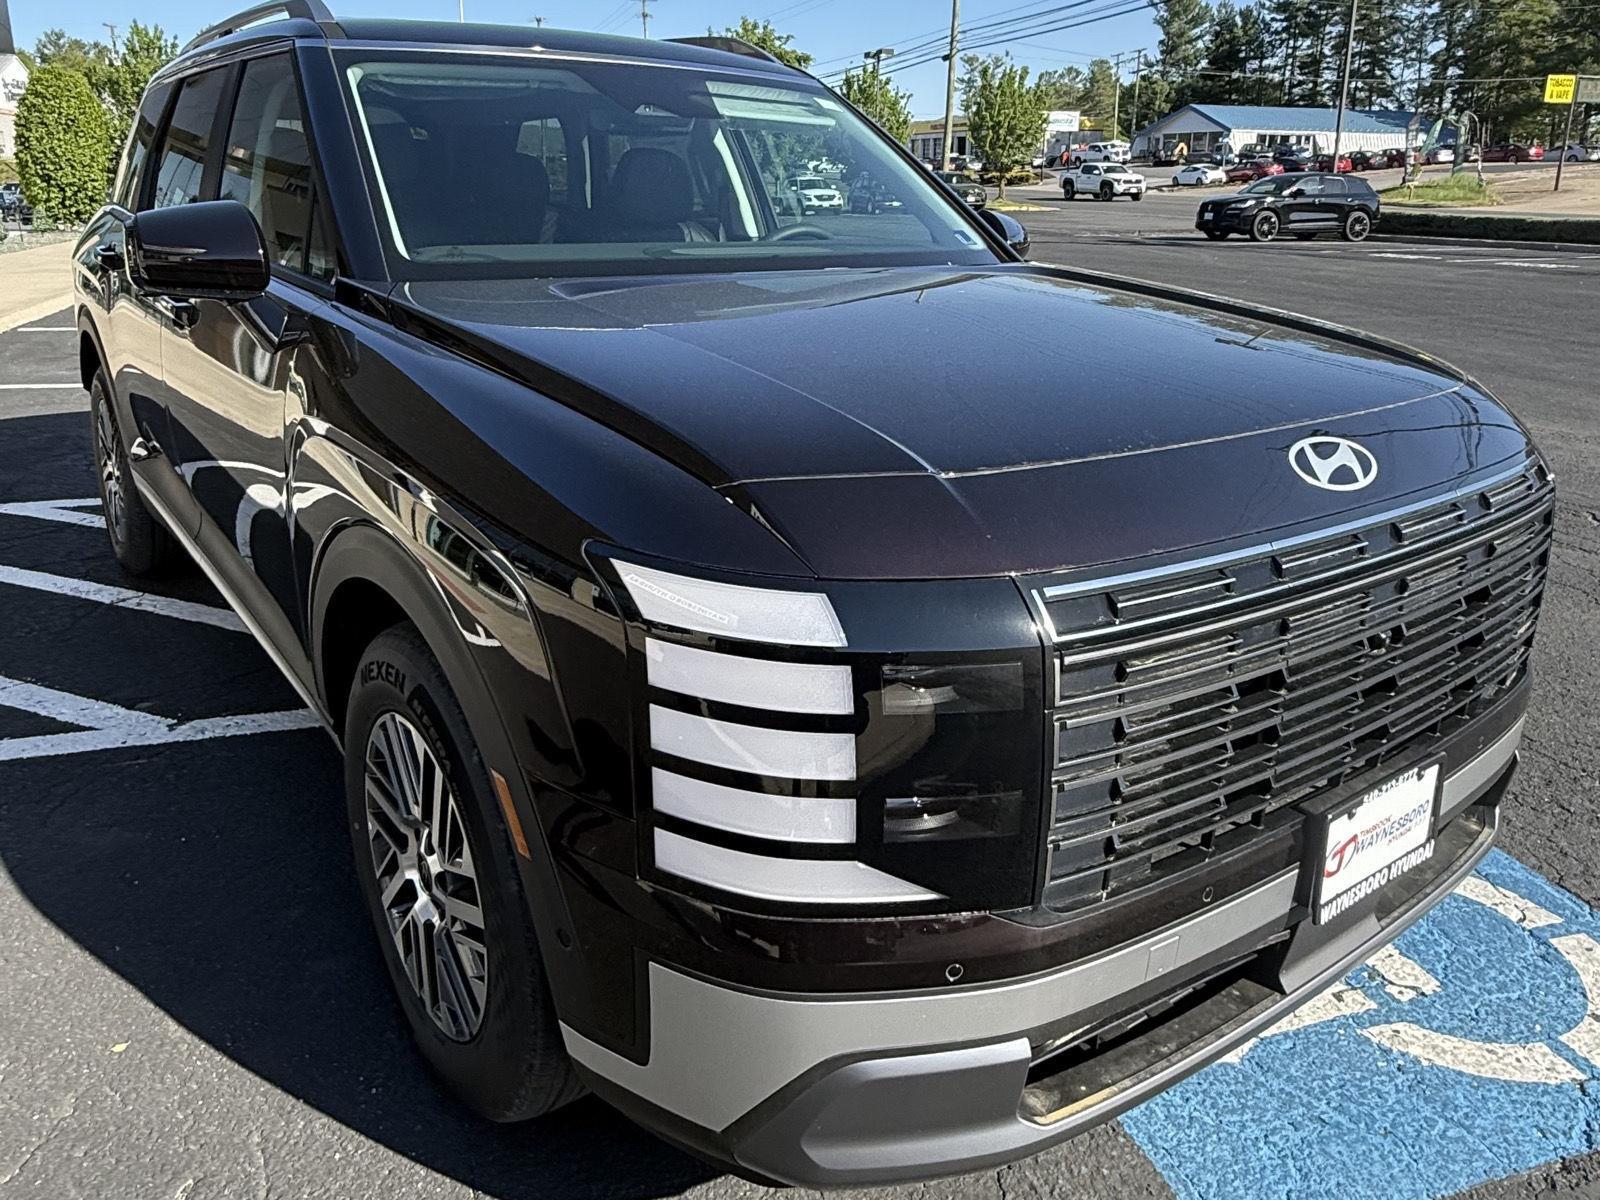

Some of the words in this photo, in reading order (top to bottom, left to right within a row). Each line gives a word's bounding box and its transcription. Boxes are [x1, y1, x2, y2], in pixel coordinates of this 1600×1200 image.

[360, 659, 406, 695] NEXEN
[1356, 799, 1430, 856] WAYNESBORO
[1320, 867, 1391, 925] WAYNESBORO
[1389, 838, 1435, 881] HYUNDAI
